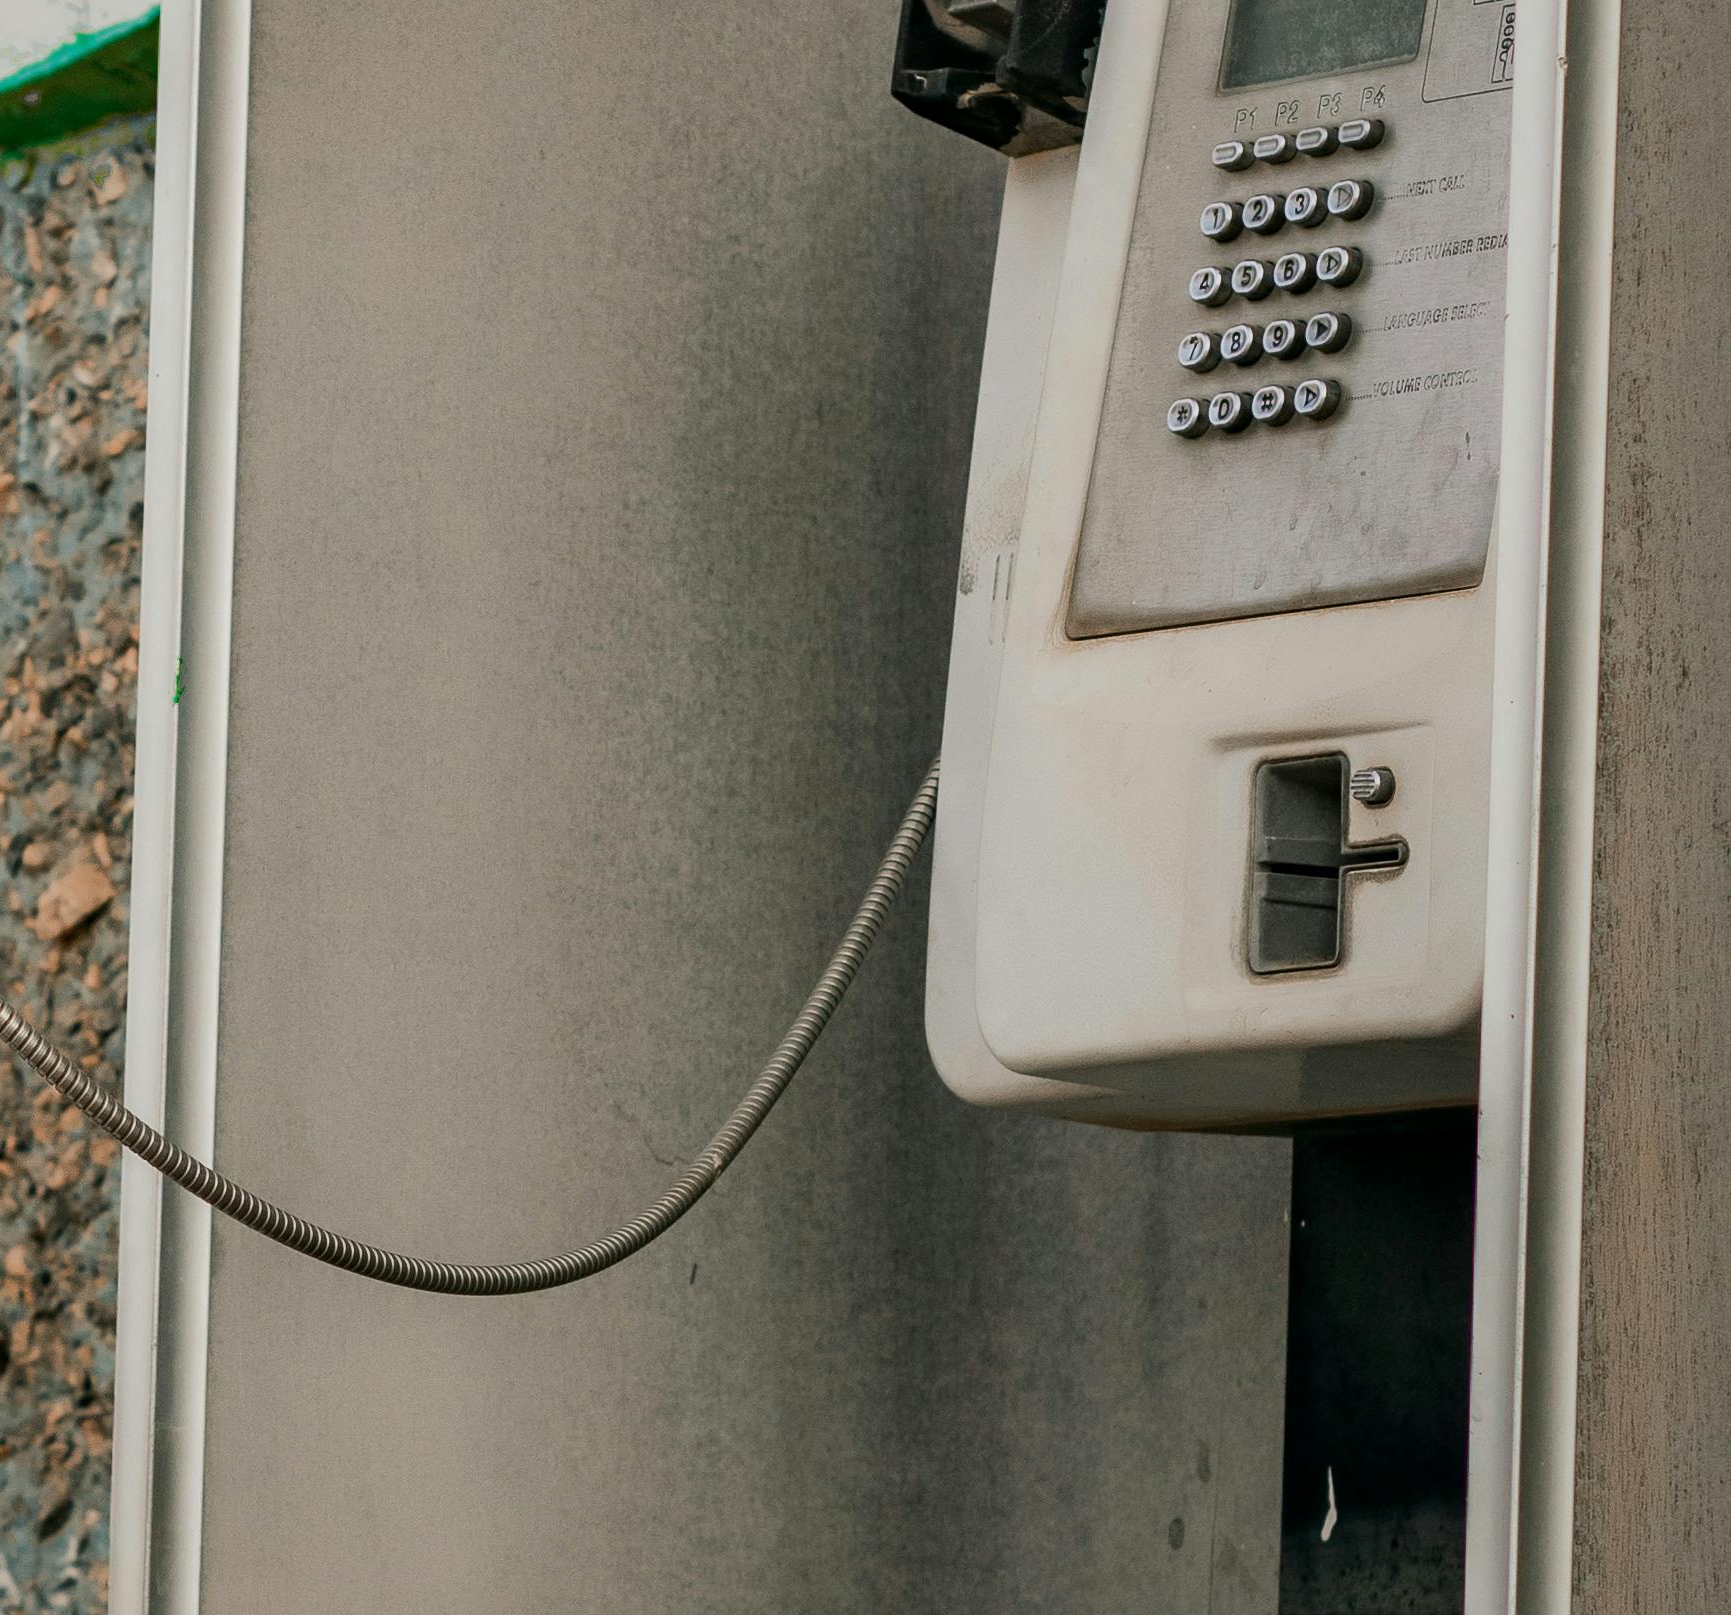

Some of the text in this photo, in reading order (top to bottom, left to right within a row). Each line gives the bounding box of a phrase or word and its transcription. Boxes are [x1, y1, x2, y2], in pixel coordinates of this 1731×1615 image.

[1234, 84, 1386, 133] P1 P2 P3 P4
[1405, 174, 1466, 198] NEXT CALL
[1252, 200, 1264, 222] 2
[1294, 193, 1305, 215] 3
[1394, 247, 1423, 266] LAST
[1423, 238, 1473, 261] NUMBER
[1199, 260, 1294, 292] 4 5 6
[1383, 301, 1491, 331] LANGUAGE SELECT
[1230, 331, 1241, 353] 8
[1272, 326, 1283, 348] 9
[1373, 368, 1478, 398] VOLUME CONTROL
